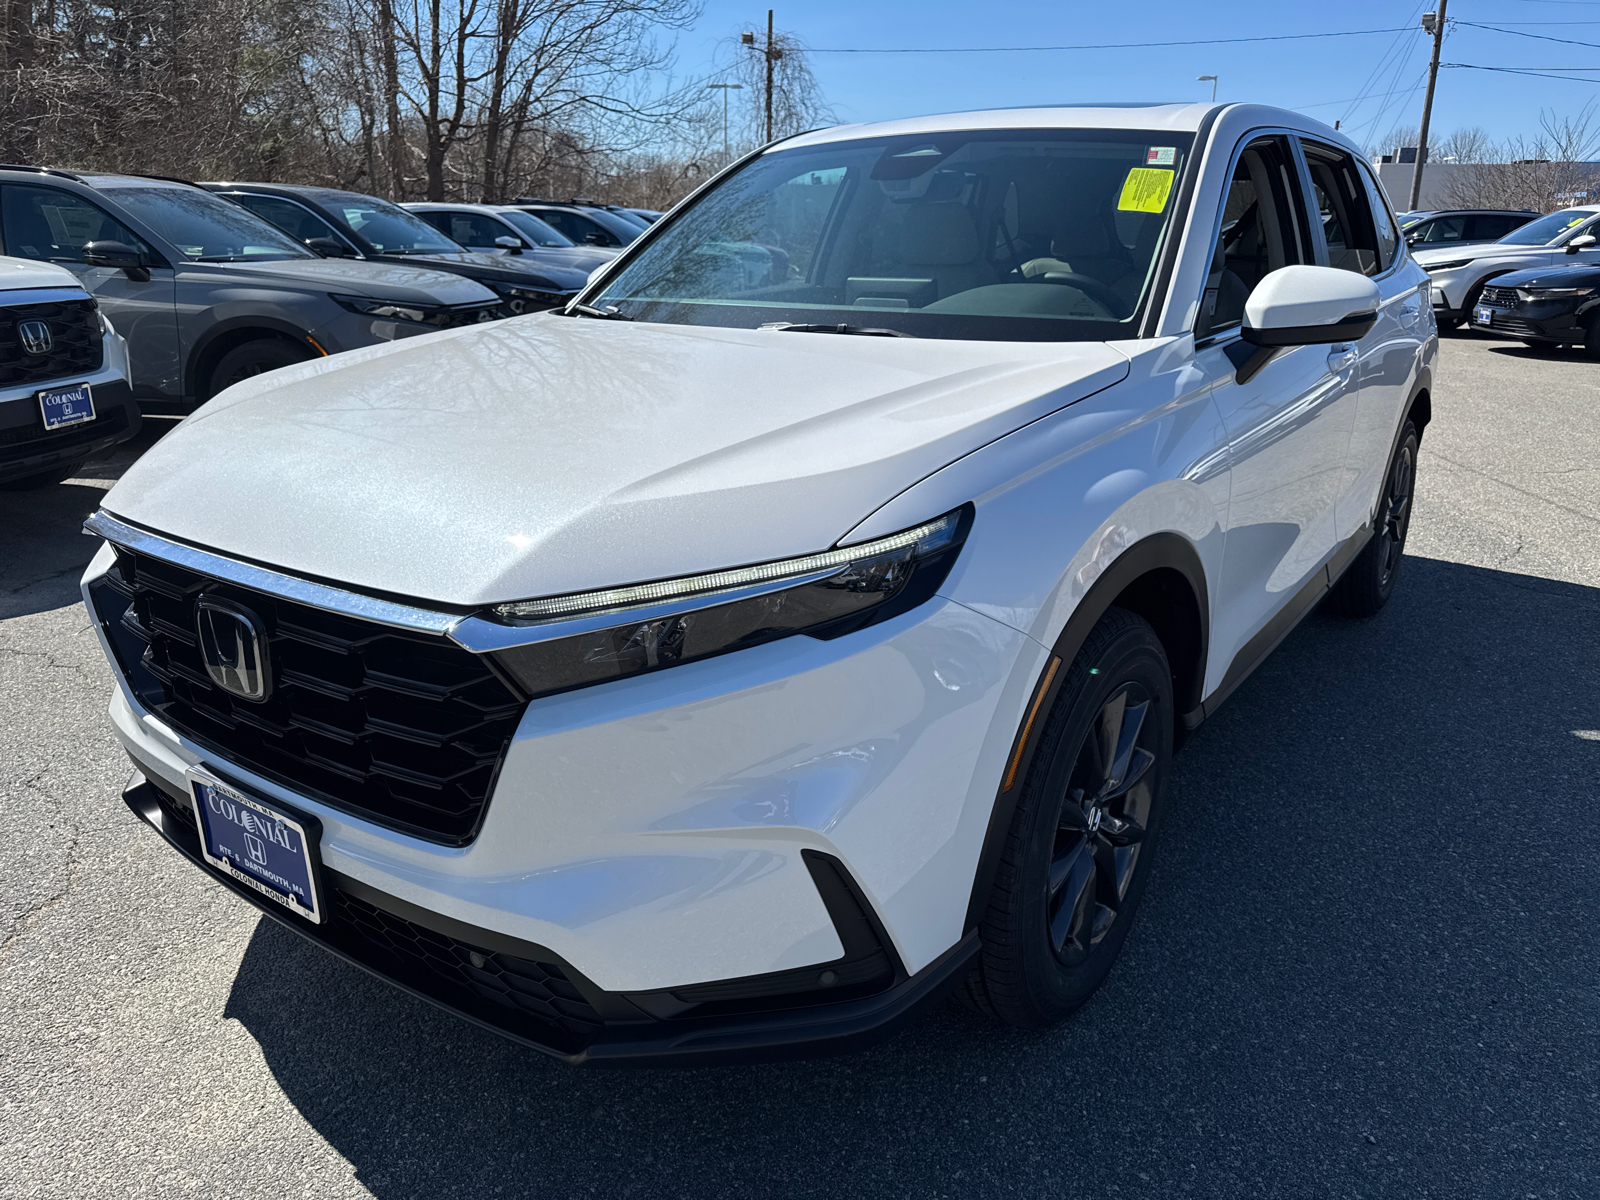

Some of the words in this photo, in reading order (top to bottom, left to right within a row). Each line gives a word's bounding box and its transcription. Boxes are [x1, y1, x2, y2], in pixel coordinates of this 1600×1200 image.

[46, 390, 84, 406] COLONIAL
[208, 793, 297, 853] COLONIAL
[230, 868, 264, 893] COLONIAL
[264, 887, 290, 908] HONDA
[292, 883, 305, 897] MA
